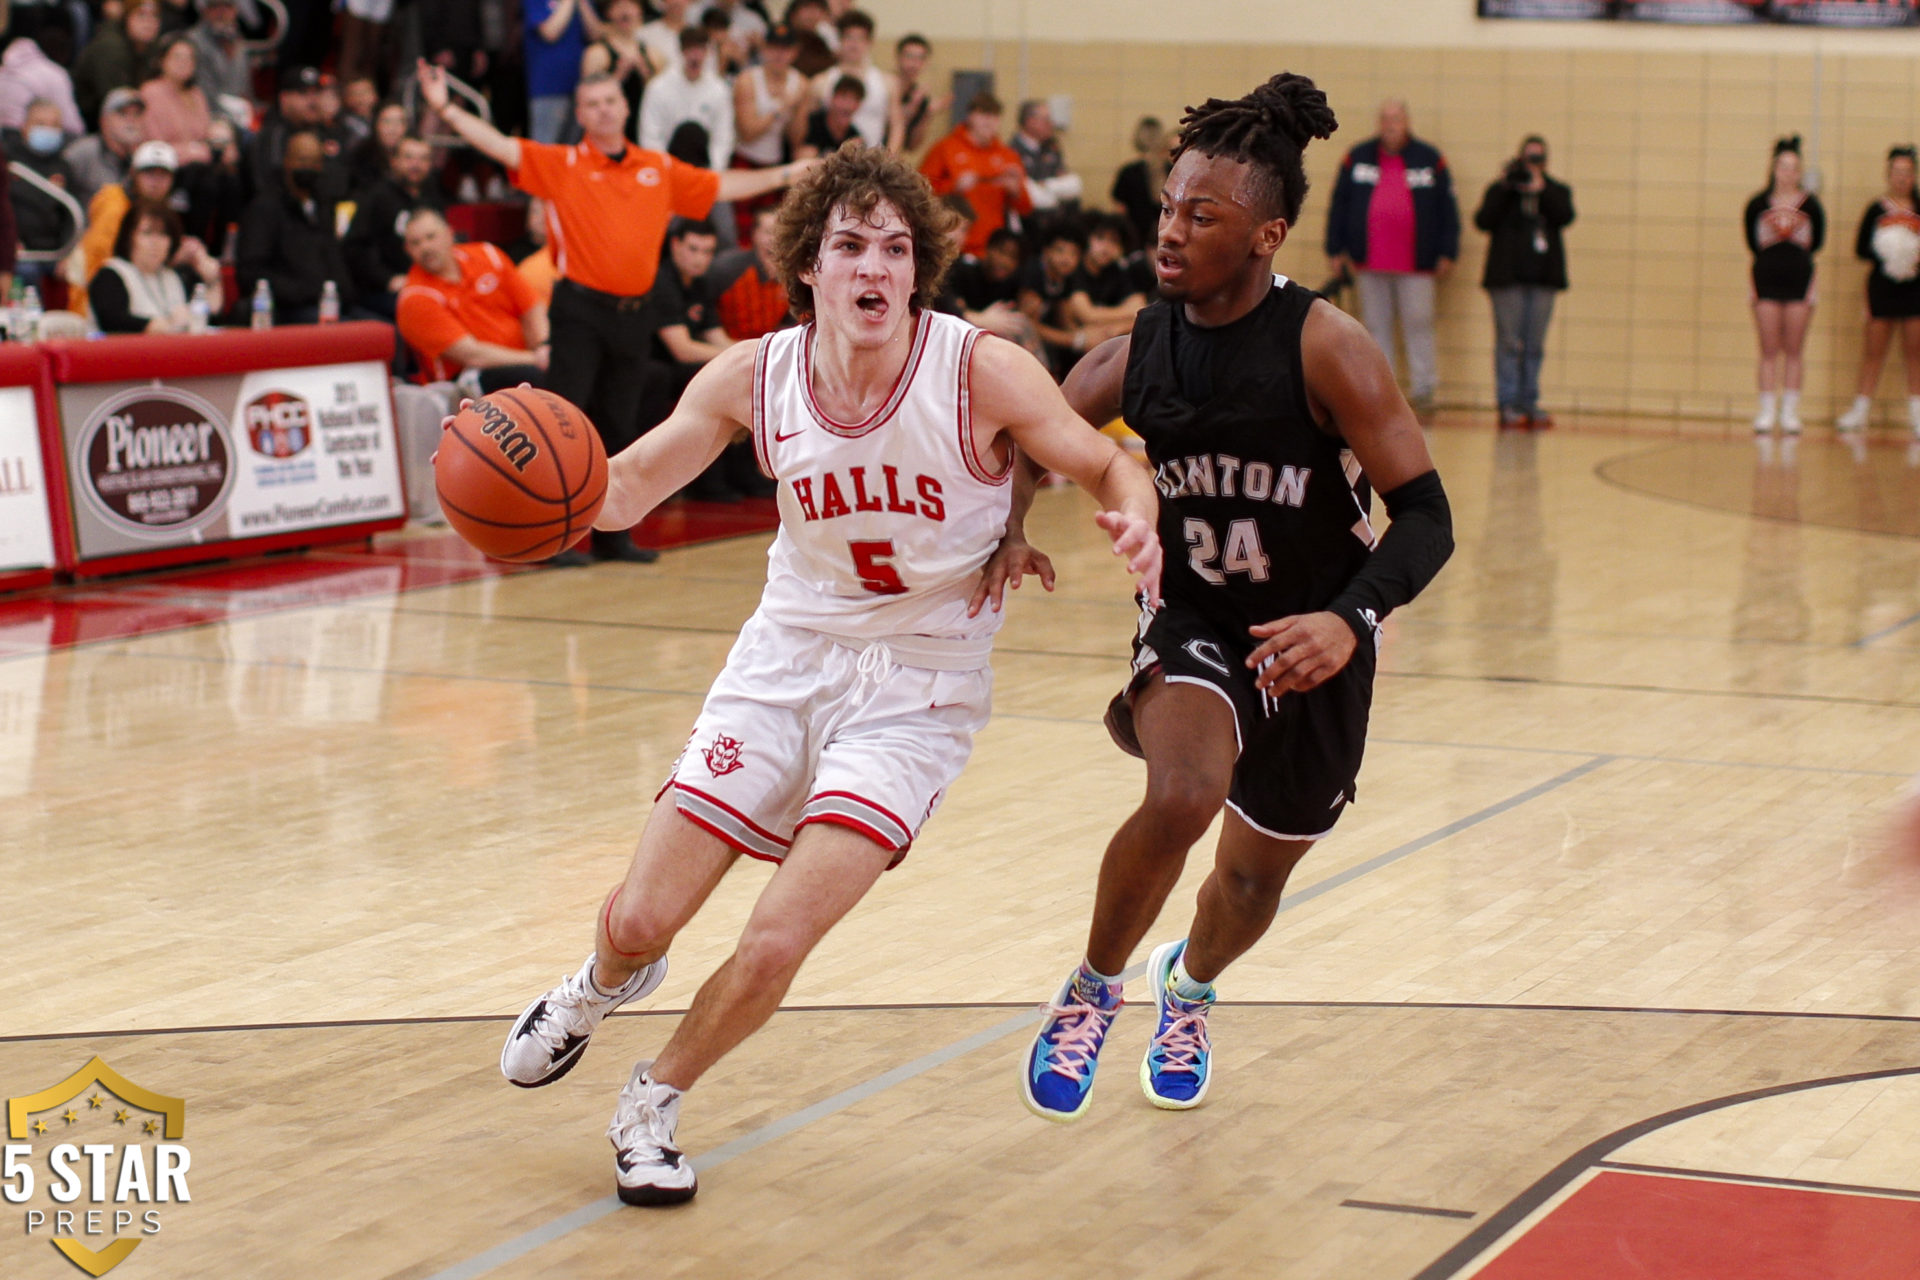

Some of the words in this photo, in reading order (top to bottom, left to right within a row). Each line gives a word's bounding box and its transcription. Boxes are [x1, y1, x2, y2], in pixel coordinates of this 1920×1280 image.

[105, 413, 213, 472] Pioneer
[0, 456, 33, 496] LL
[792, 464, 945, 522] HALLS
[848, 538, 910, 596] 5
[1183, 517, 1270, 586] 24
